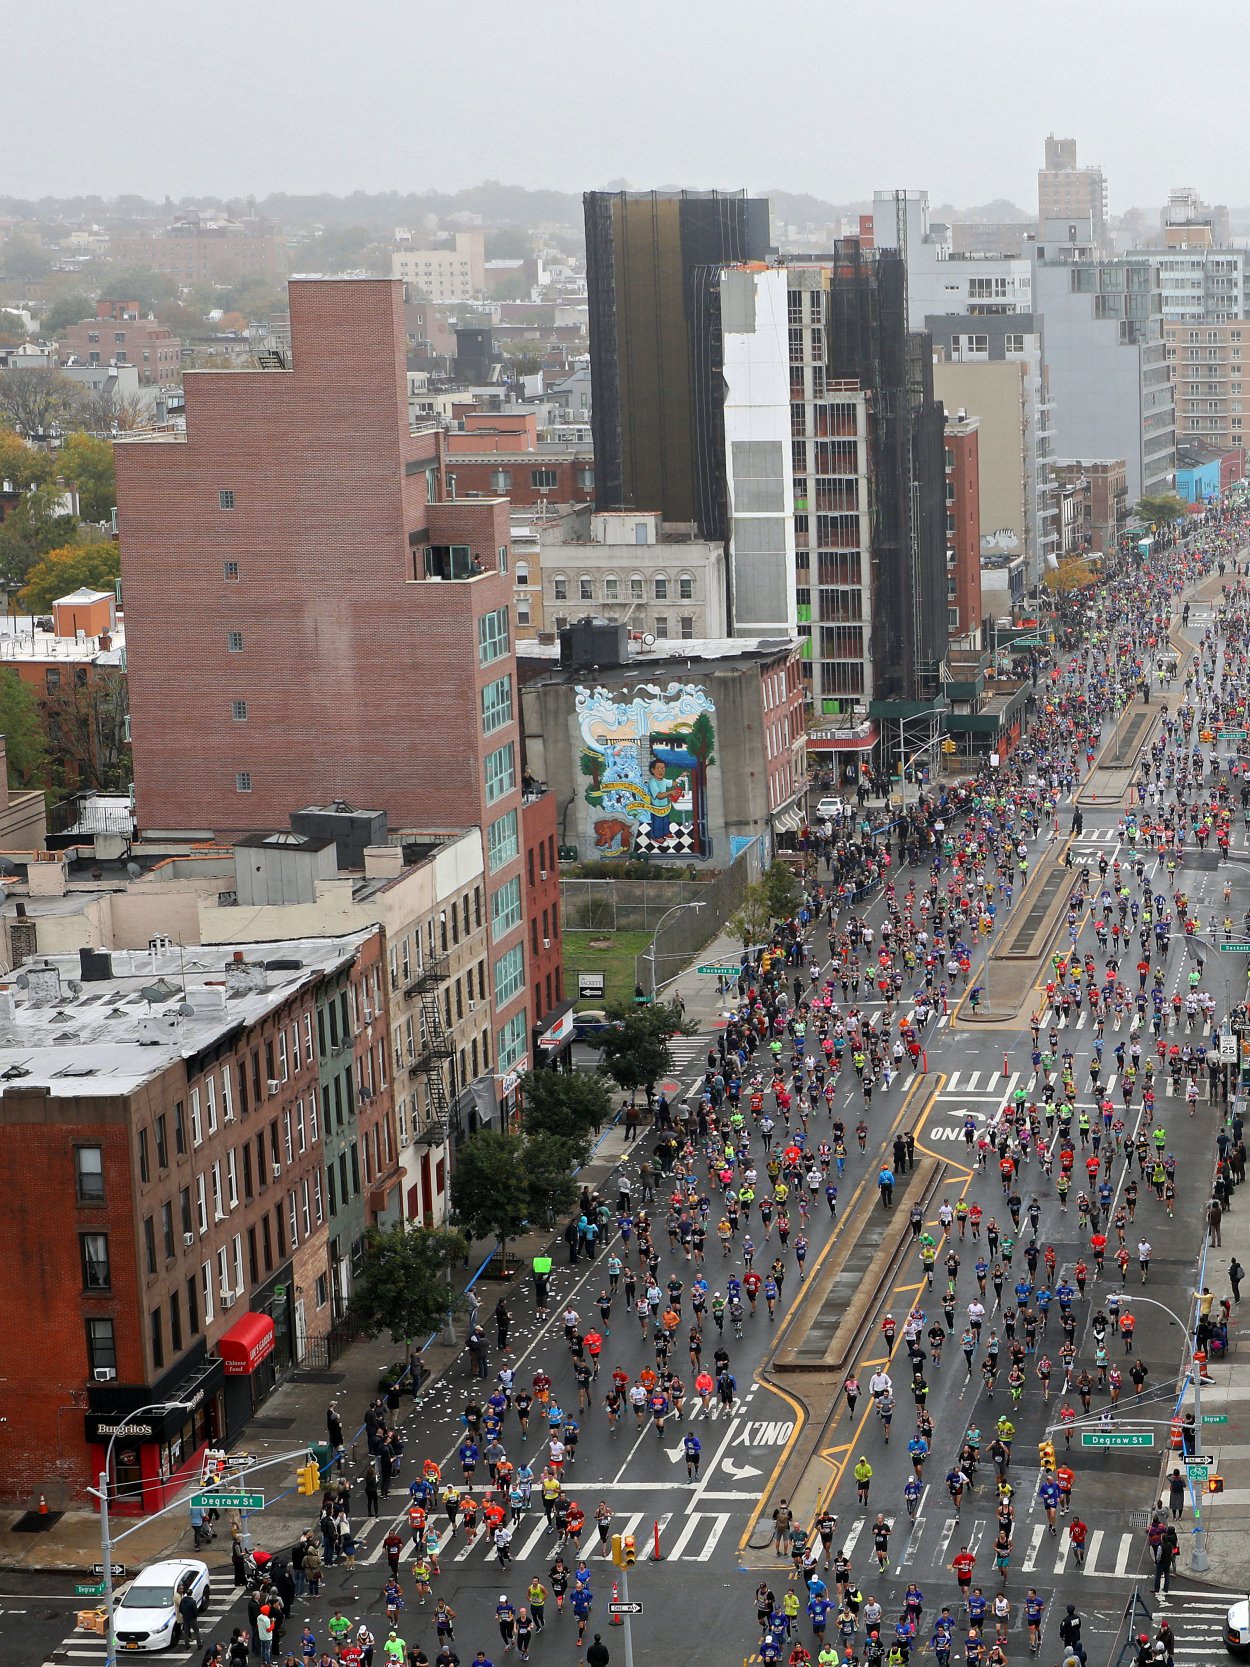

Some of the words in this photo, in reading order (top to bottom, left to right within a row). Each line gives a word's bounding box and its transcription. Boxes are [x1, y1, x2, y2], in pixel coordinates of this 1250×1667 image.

[1222, 1046, 1235, 1054] 25
[97, 1424, 152, 1437] Burgrito's
[732, 1421, 795, 1447] ONLY
[1092, 1436, 1129, 1445] Degraw
[1132, 1436, 1143, 1444] St
[201, 1497, 240, 1507] Degraw
[242, 1497, 254, 1505] St
[78, 1586, 96, 1595] Degraw
